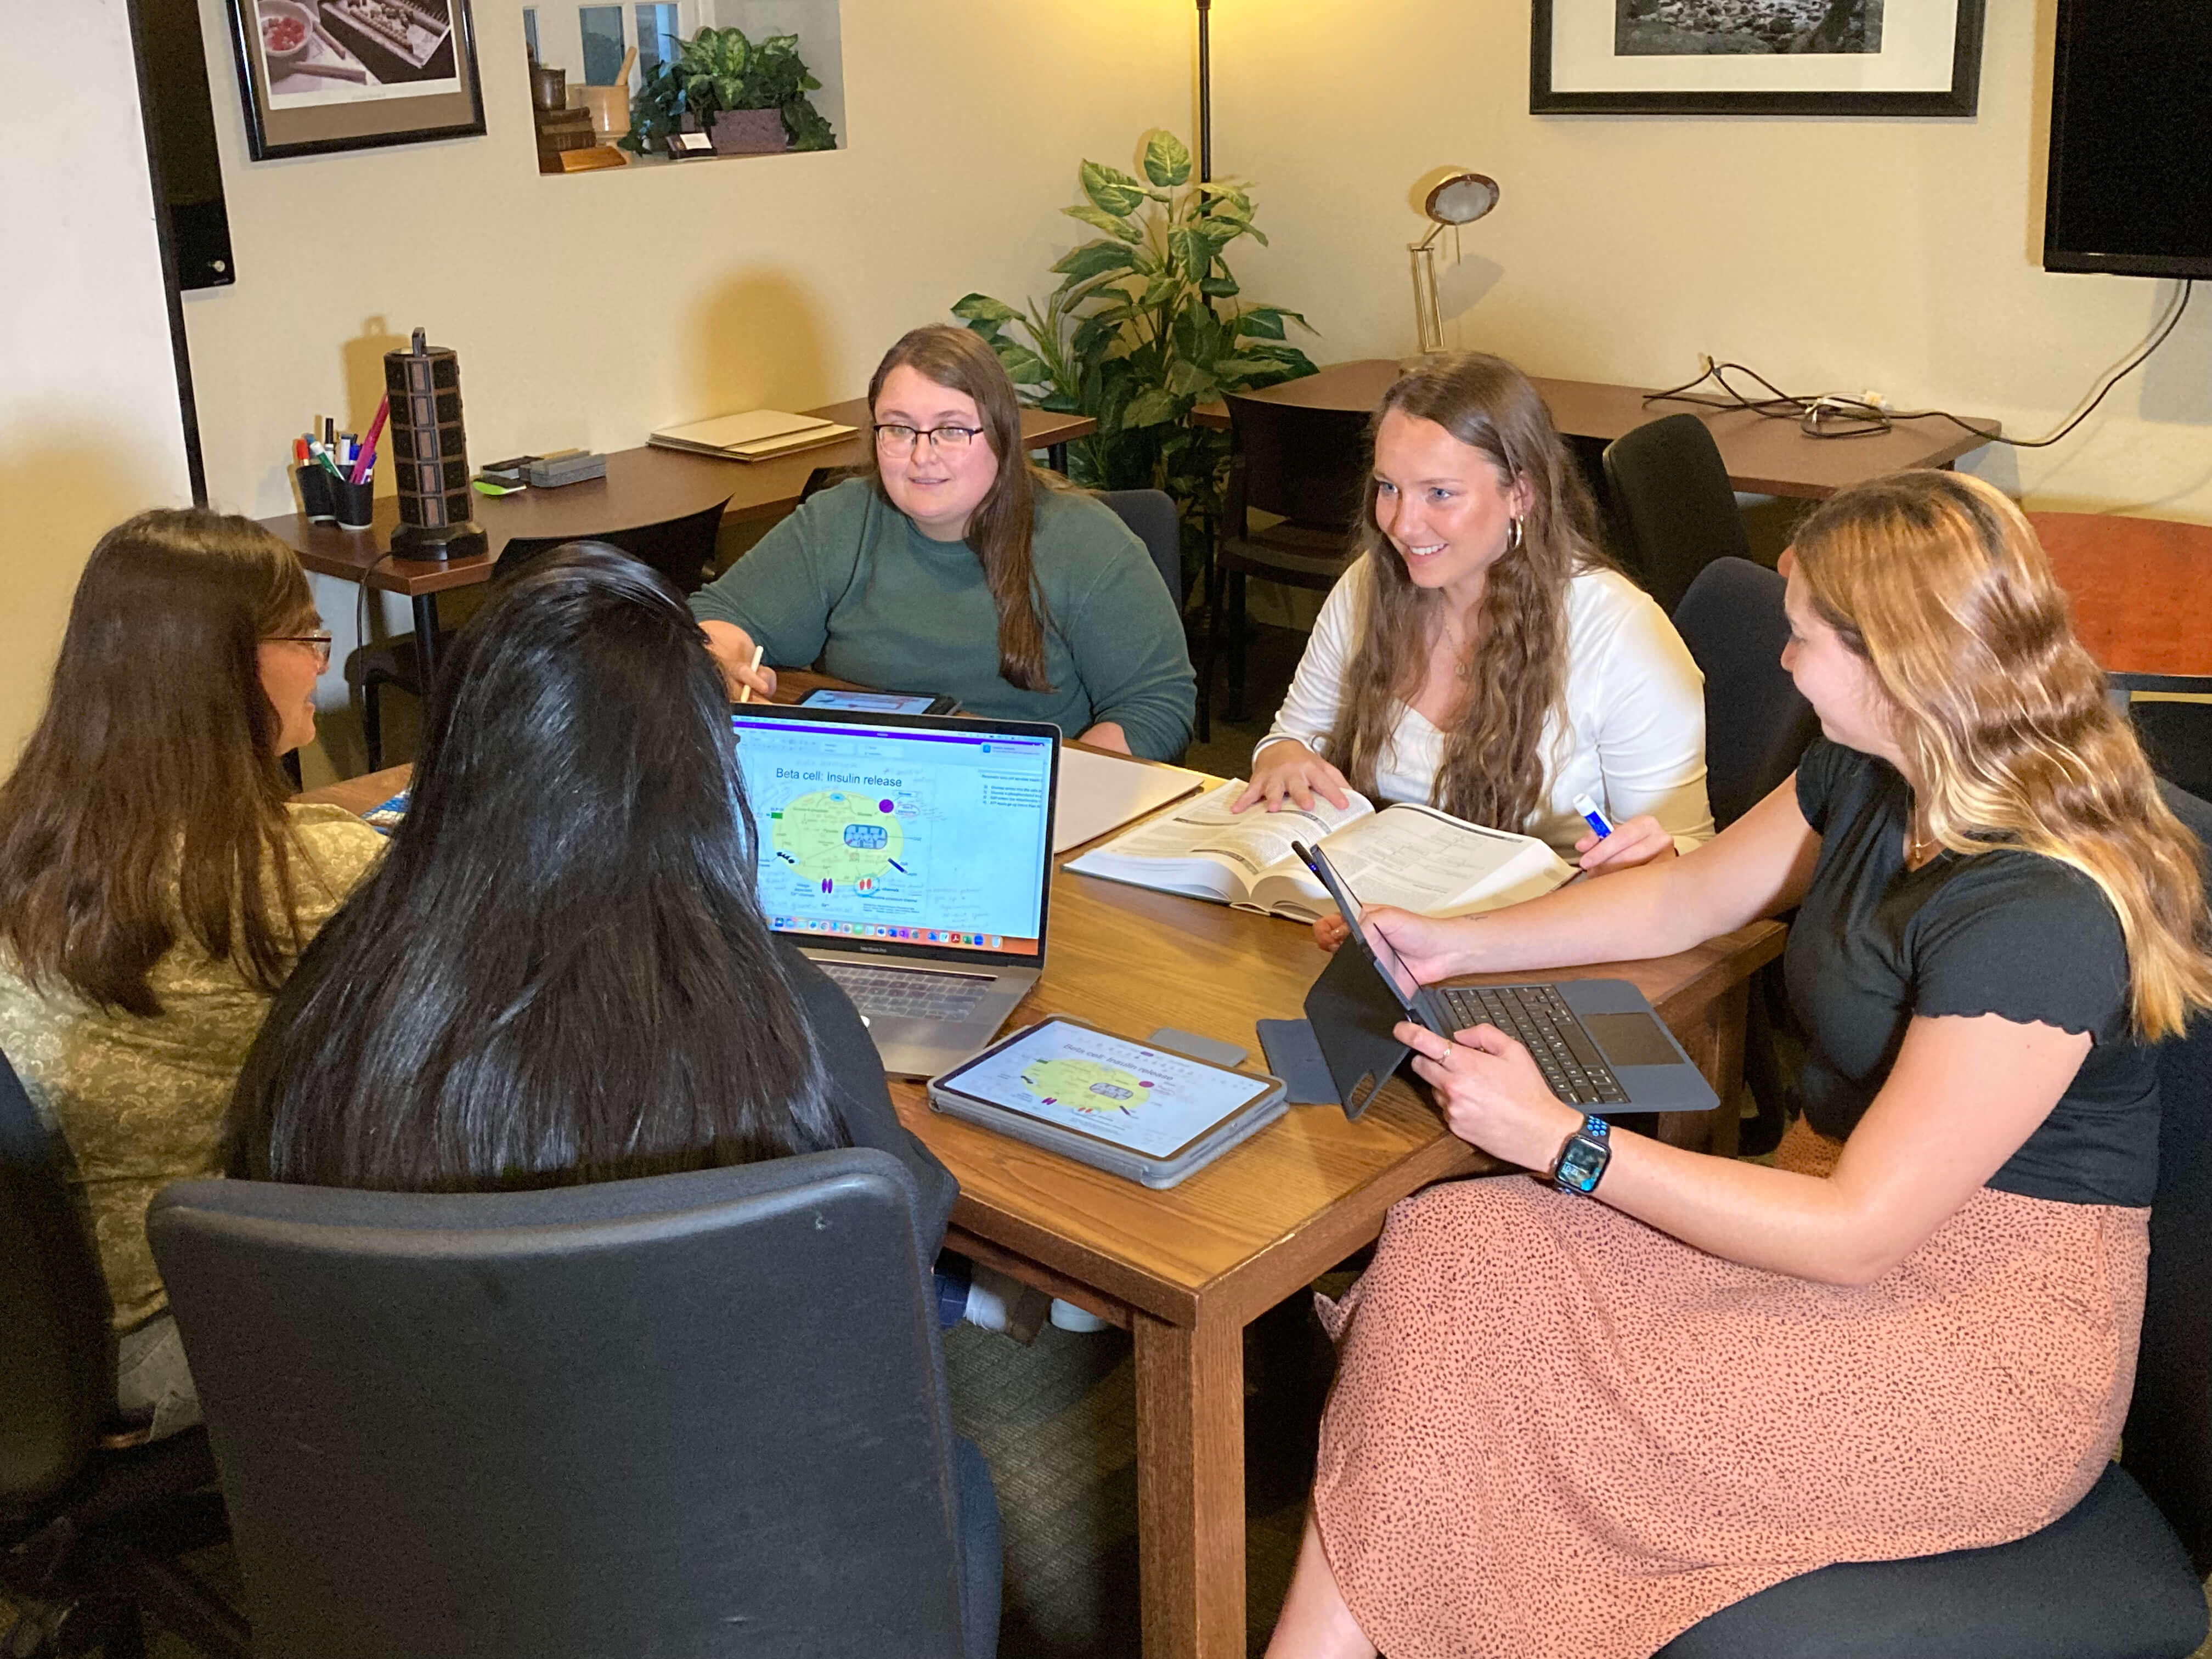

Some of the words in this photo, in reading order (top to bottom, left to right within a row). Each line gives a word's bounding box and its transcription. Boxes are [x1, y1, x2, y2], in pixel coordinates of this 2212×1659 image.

[776, 768, 799, 779] Beta
[803, 771, 823, 781] cell:
[827, 772, 860, 784] Insulin
[864, 776, 902, 787] release
[1063, 1043, 1085, 1053] Beta
[1106, 1057, 1137, 1070] Insulin
[1138, 1067, 1173, 1081] release
